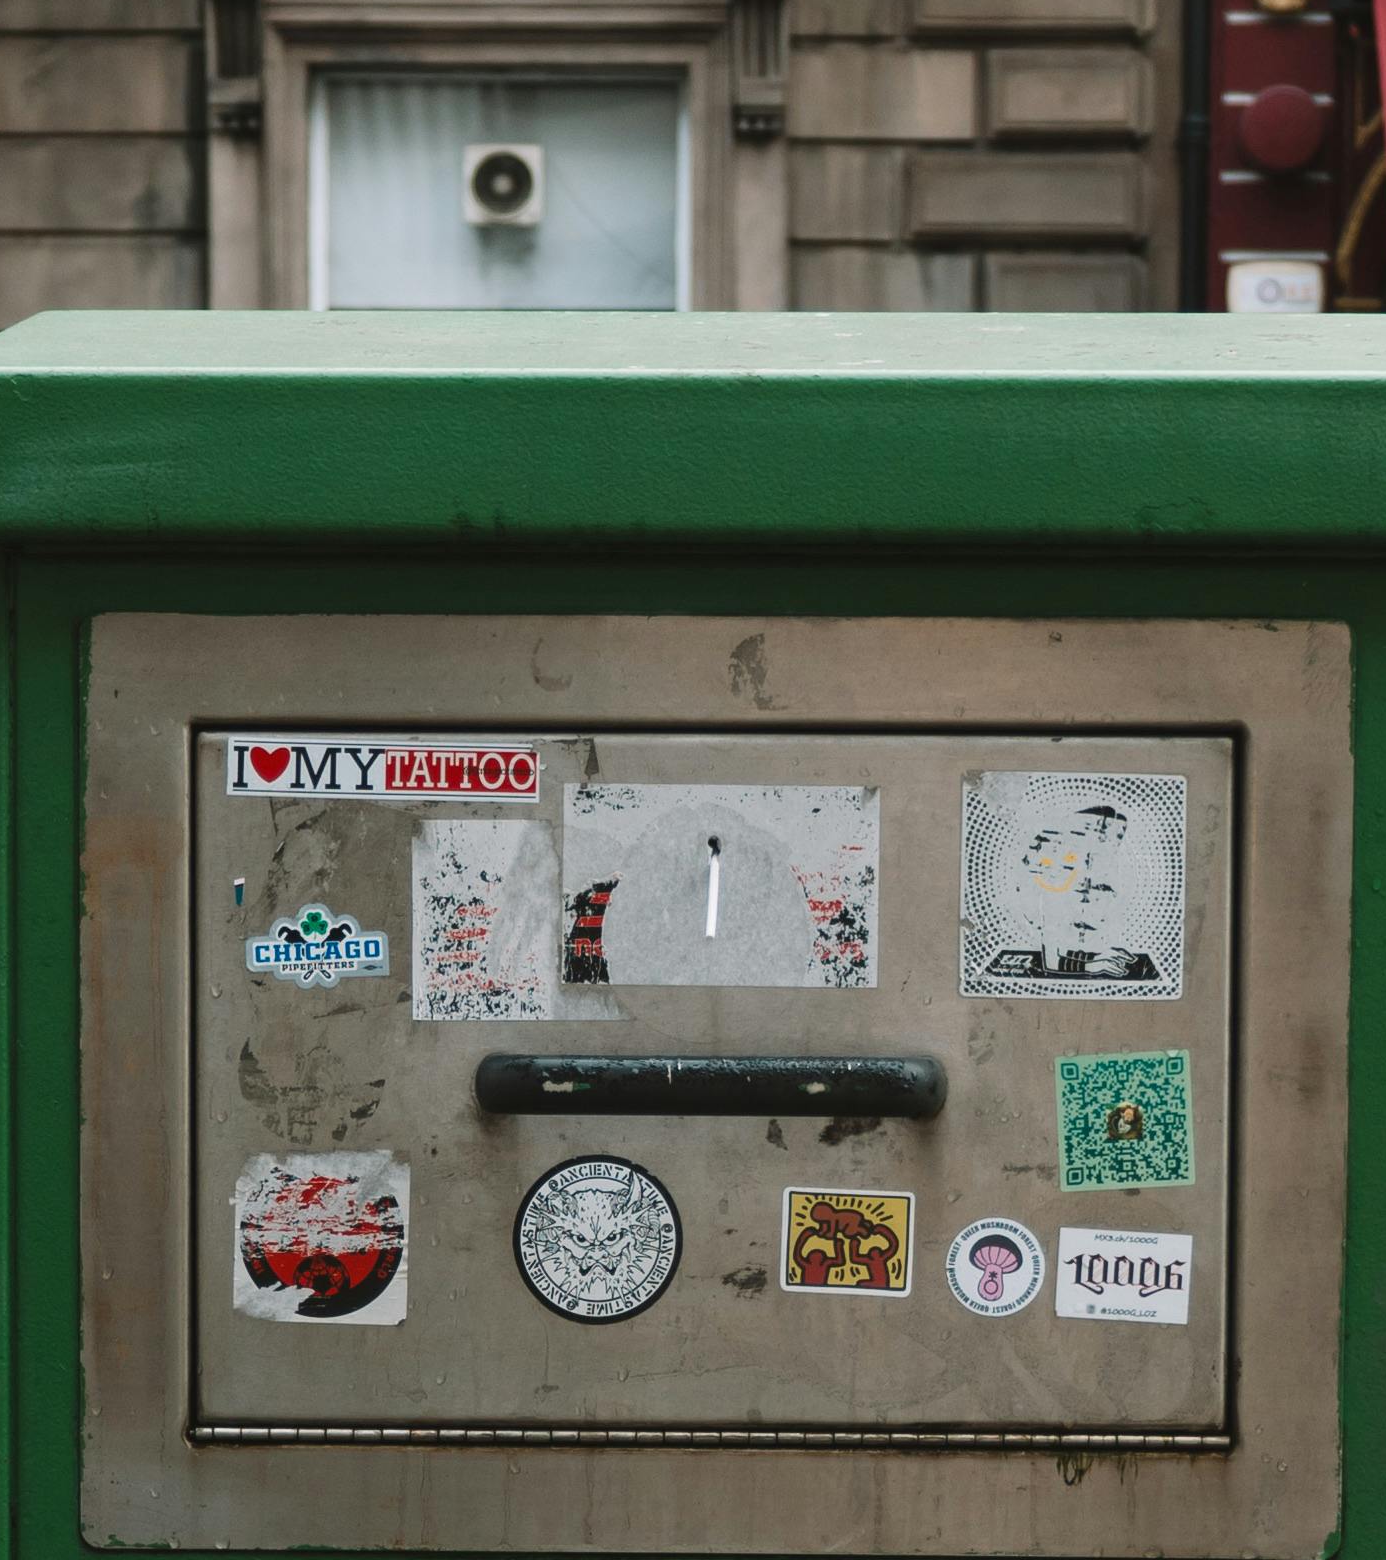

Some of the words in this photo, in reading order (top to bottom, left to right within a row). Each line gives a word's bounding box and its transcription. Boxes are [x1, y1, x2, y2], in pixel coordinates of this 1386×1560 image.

[232, 745, 250, 788] I
[290, 746, 386, 791] MY
[387, 751, 536, 790] TATTOO
[255, 940, 380, 963] CHICAGO
[281, 961, 355, 972] PIPEFITTERS
[546, 1164, 669, 1216] @ANCIENTATIME
